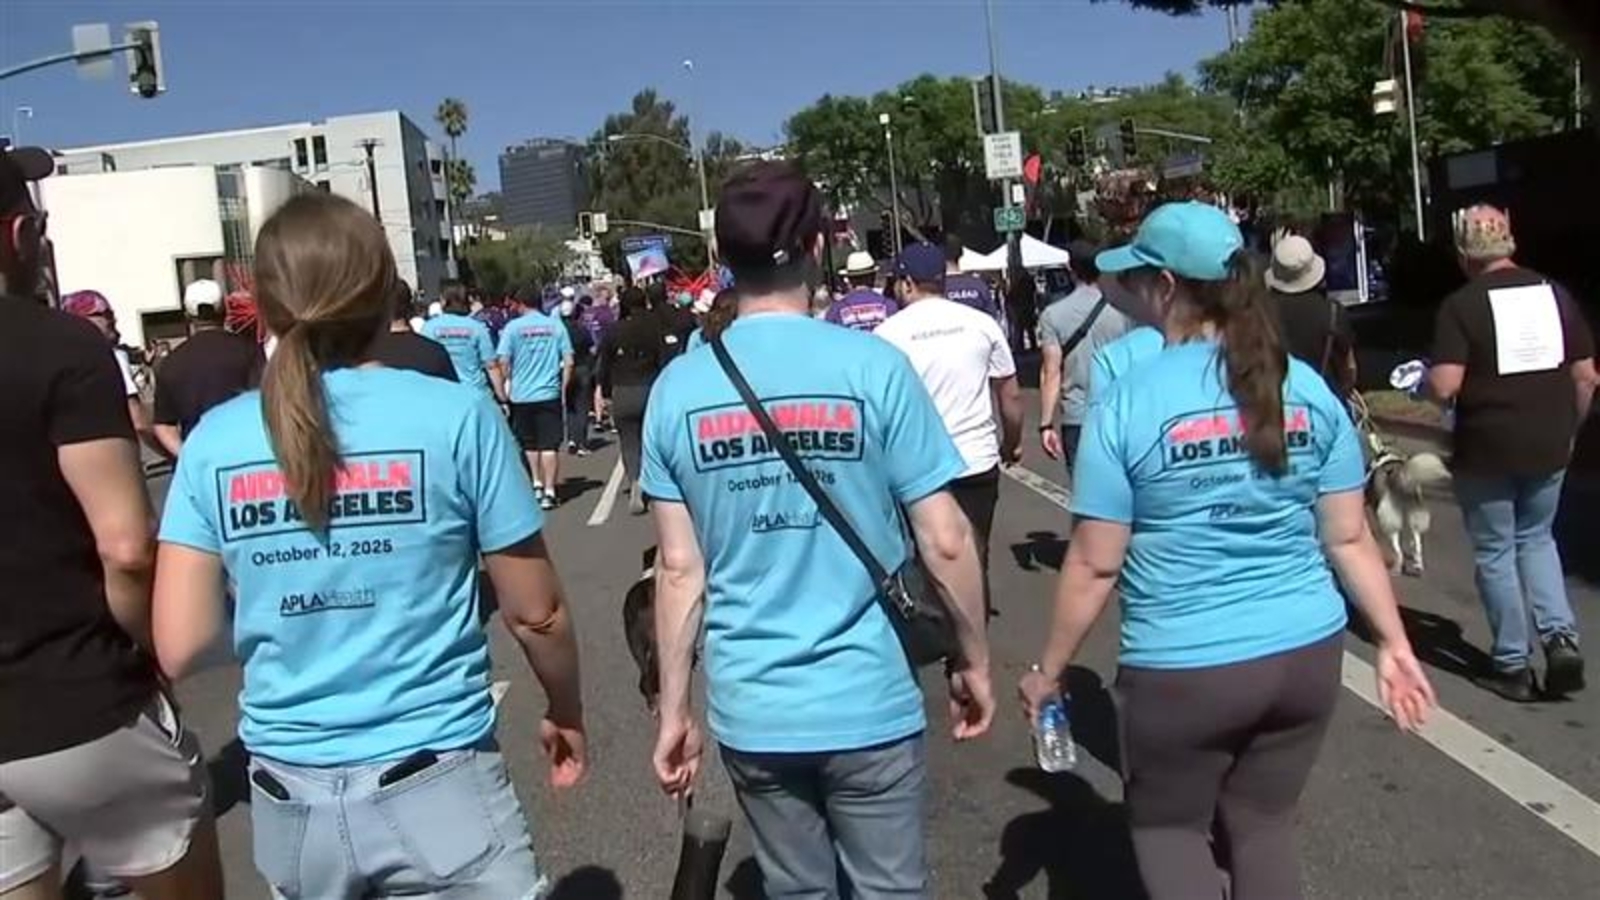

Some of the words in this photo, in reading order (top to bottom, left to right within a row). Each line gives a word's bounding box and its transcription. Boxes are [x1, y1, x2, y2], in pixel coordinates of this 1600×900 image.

[699, 437, 744, 463] LOS
[752, 430, 855, 454] AGELES
[1170, 439, 1212, 464] LOS
[229, 501, 277, 531] LOS
[284, 489, 415, 523] AGELES
[252, 545, 320, 567] October
[350, 539, 393, 556] 2025
